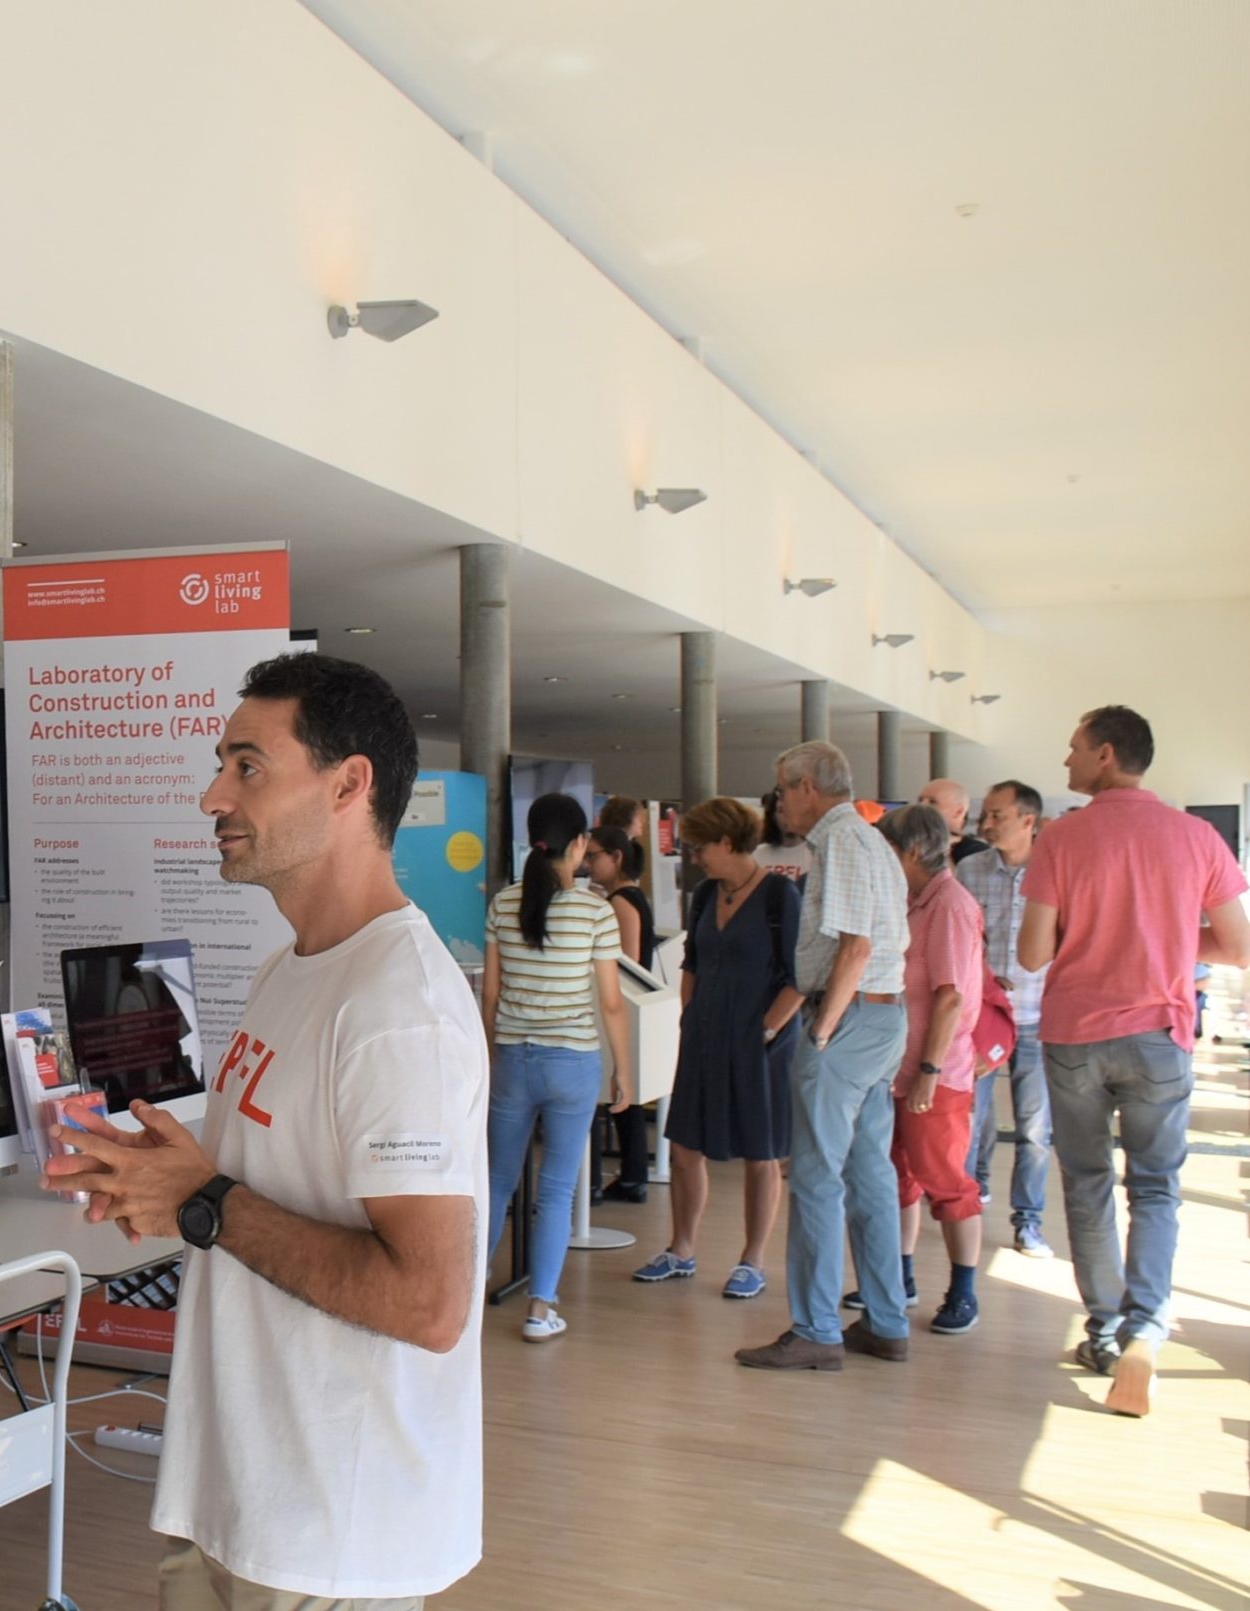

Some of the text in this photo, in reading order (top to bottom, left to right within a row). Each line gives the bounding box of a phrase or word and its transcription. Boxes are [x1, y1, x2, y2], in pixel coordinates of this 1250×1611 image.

[214, 570, 260, 584] smart
[215, 584, 262, 600] living
[215, 600, 239, 613] lab
[29, 661, 174, 686] Laboratory of
[29, 689, 215, 713] Construction and
[30, 719, 163, 740] Architecture
[32, 753, 185, 768] FAR is both an adjective
[32, 773, 195, 787] (distant) and an acronym:
[33, 793, 53, 805] For
[57, 796, 72, 805] an
[75, 793, 153, 805] Architecture
[157, 792, 170, 804] of
[174, 792, 195, 804] the
[34, 839, 79, 850] Purpose
[154, 839, 207, 849] Research
[211, 1029, 275, 1128] PFL
[405, 1153, 428, 1162] living
